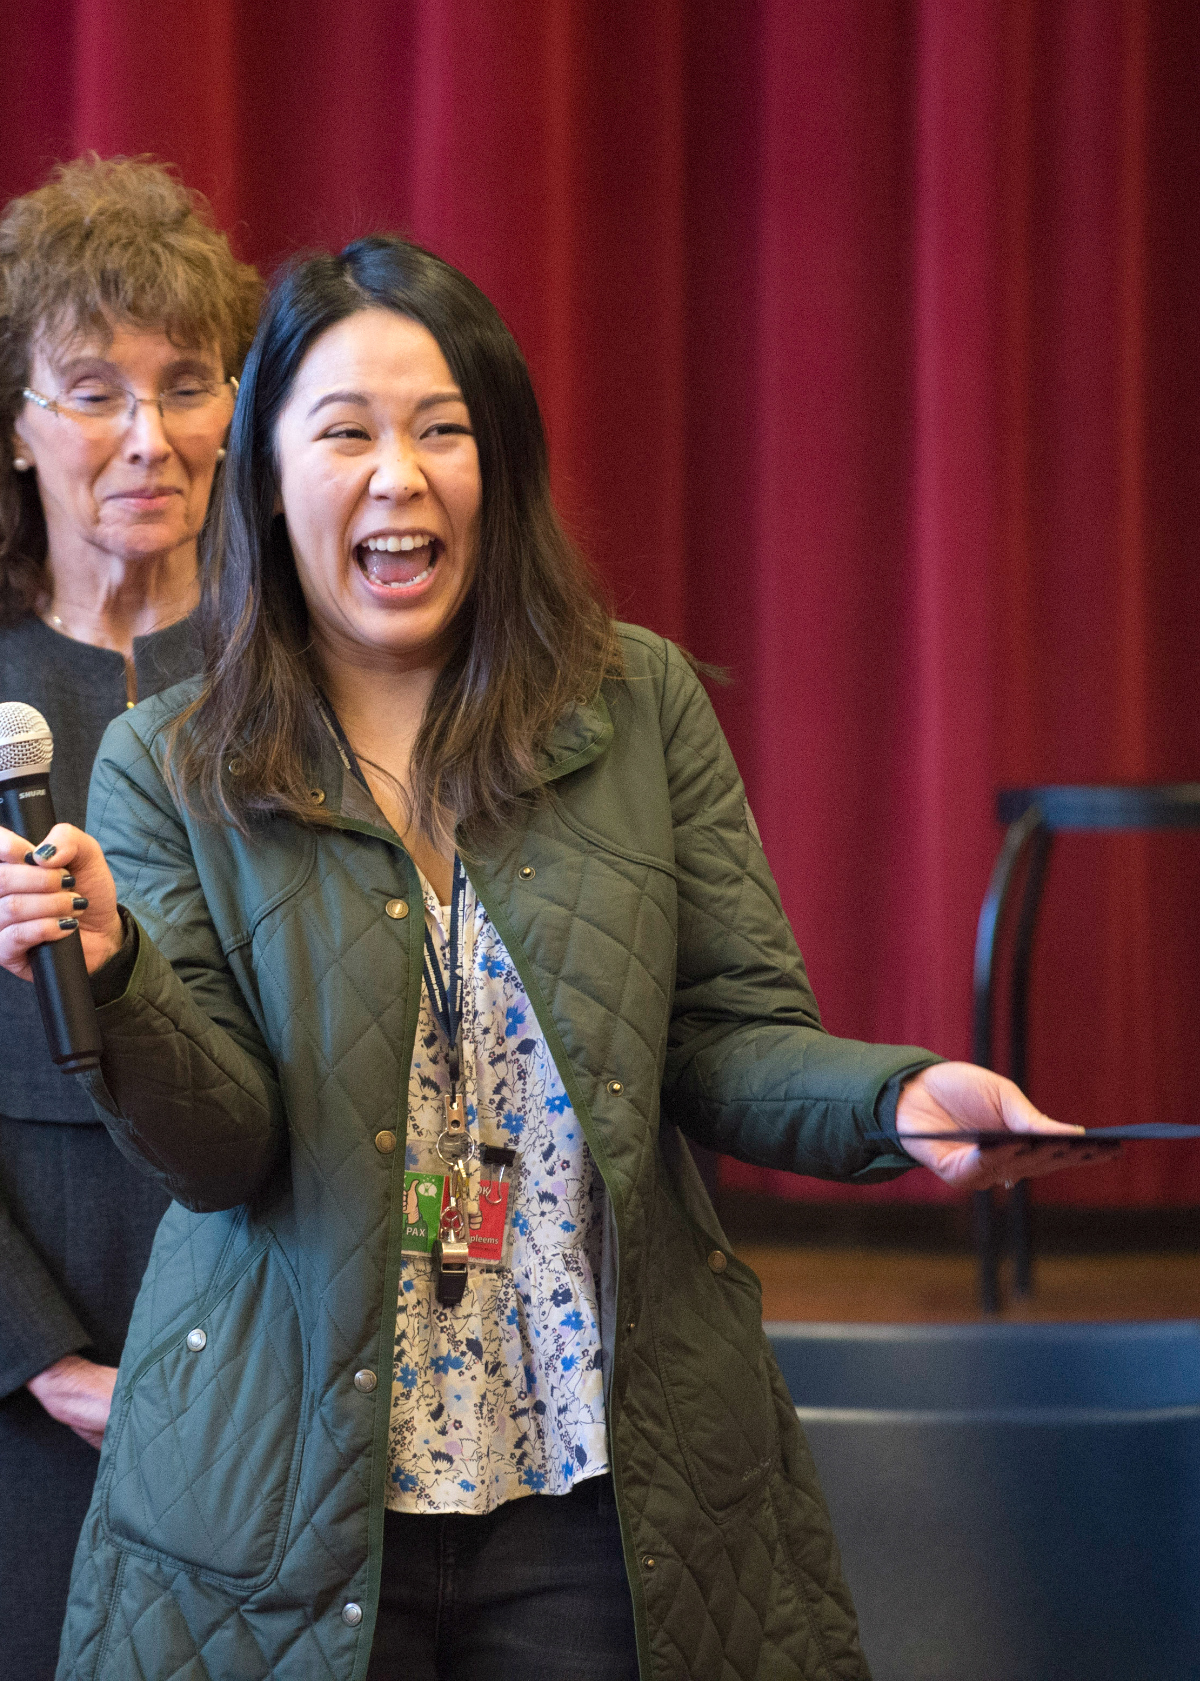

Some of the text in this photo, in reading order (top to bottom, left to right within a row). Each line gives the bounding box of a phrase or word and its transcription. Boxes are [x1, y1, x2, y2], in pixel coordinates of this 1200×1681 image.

[18, 789, 46, 799] SHURE
[406, 1227, 426, 1237] PAX
[470, 1234, 499, 1245] pleems
